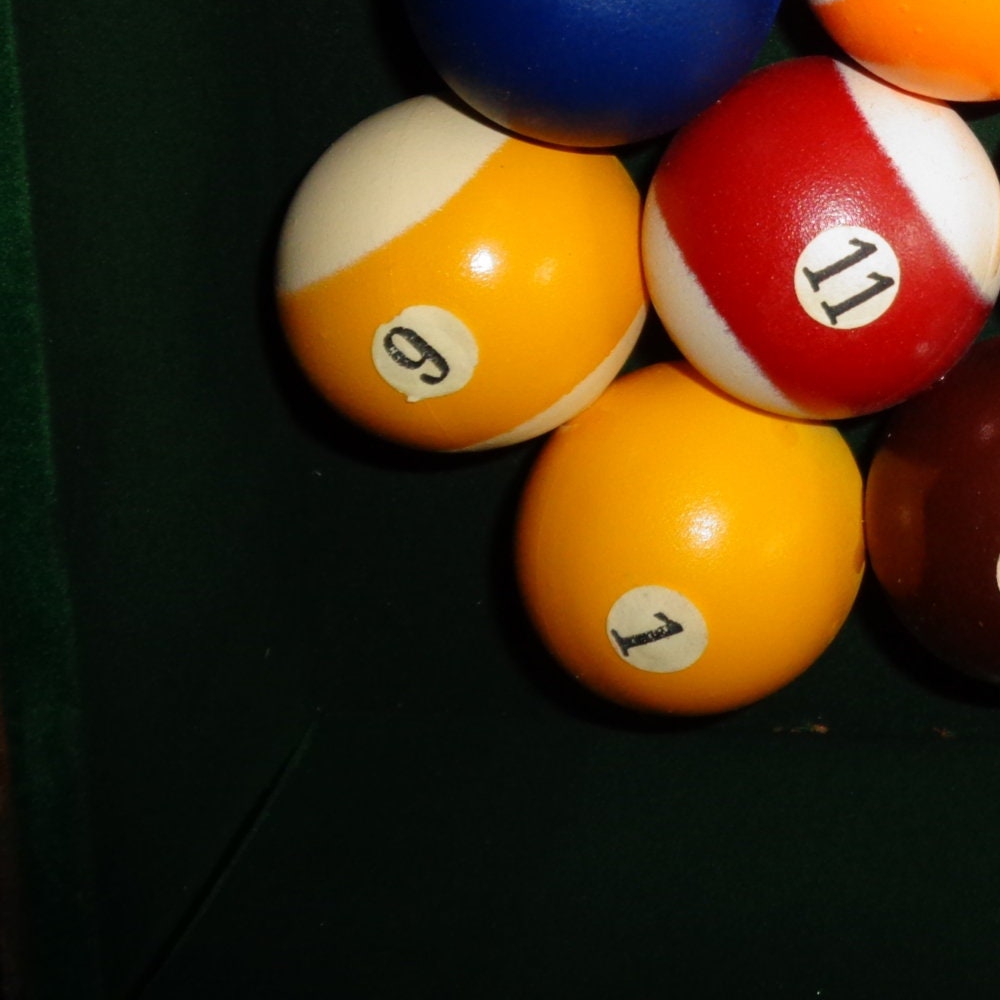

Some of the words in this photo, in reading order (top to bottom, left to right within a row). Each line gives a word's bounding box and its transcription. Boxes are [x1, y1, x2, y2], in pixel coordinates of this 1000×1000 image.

[802, 237, 896, 327] 11
[383, 326, 450, 386] 9
[610, 611, 684, 658] 1
